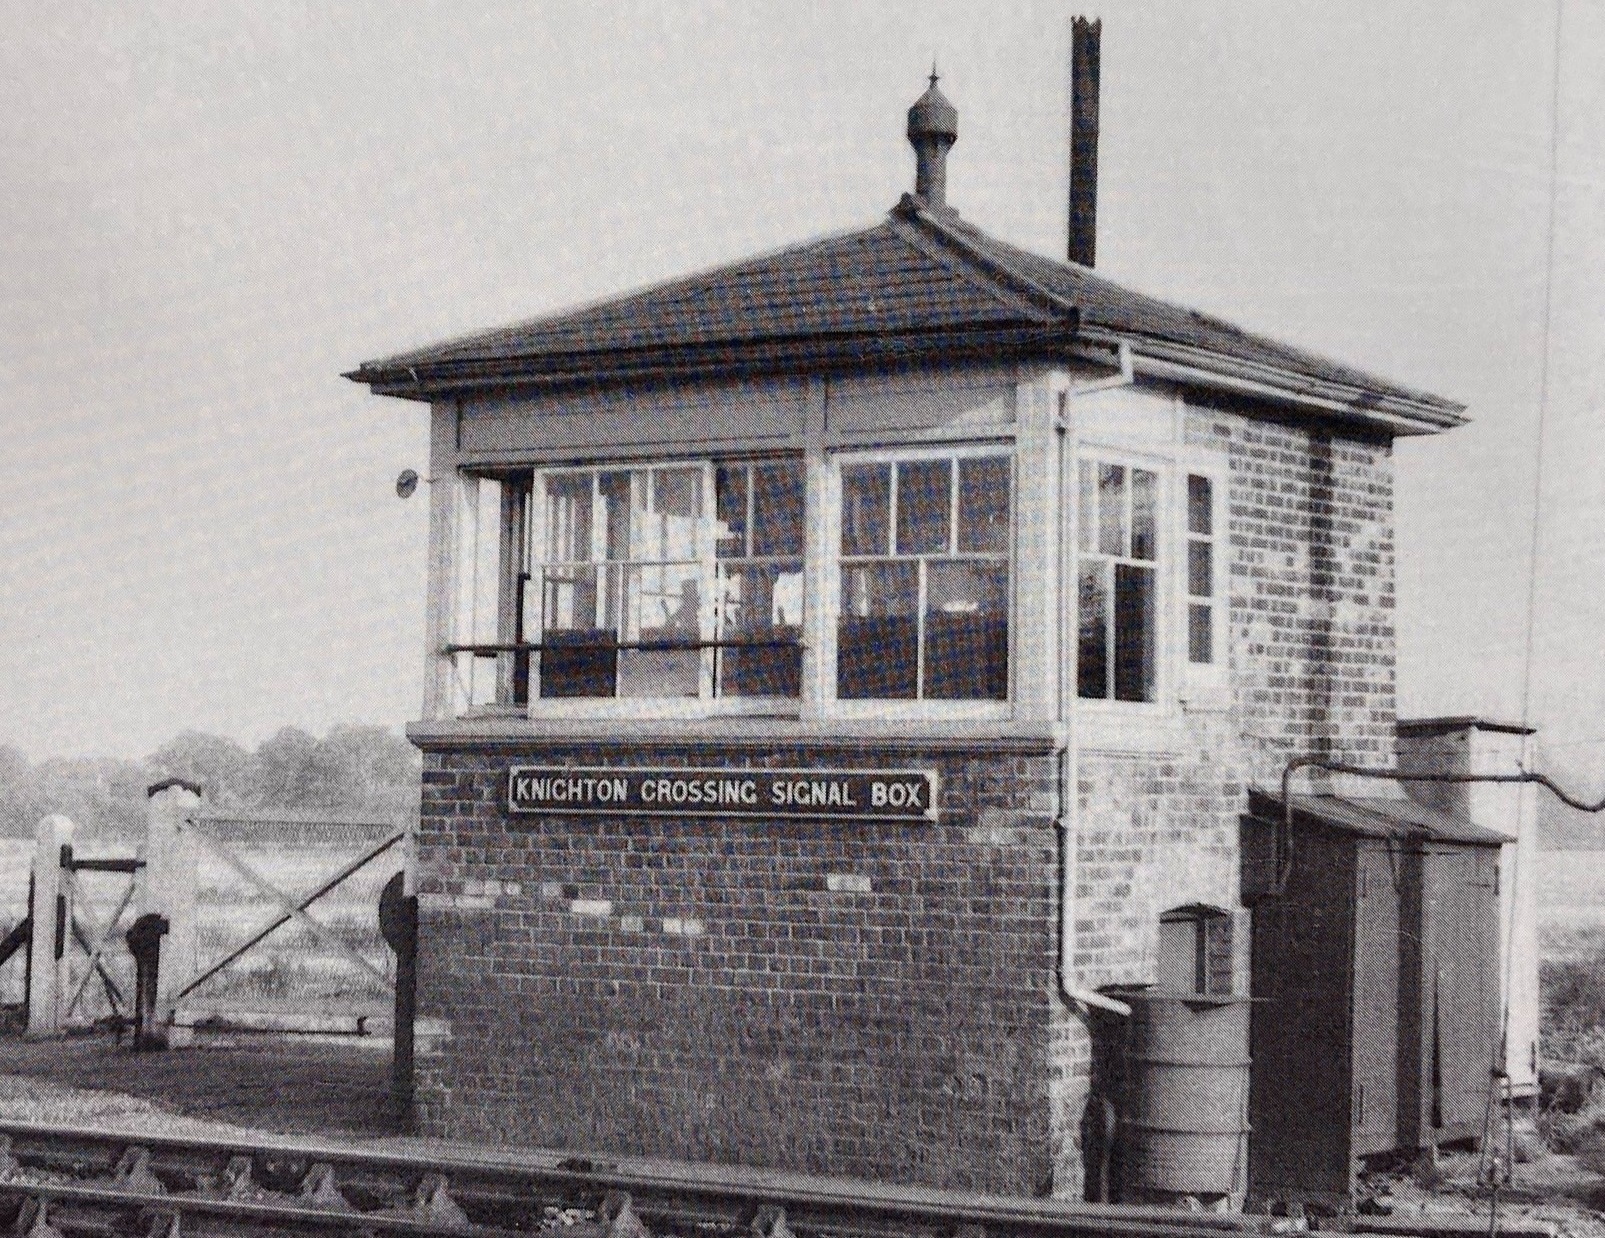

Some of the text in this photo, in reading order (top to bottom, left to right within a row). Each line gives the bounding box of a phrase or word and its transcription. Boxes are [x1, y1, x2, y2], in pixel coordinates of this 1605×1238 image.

[516, 777, 922, 808] KNIGHTON CROSSING SIGNAL BOX
